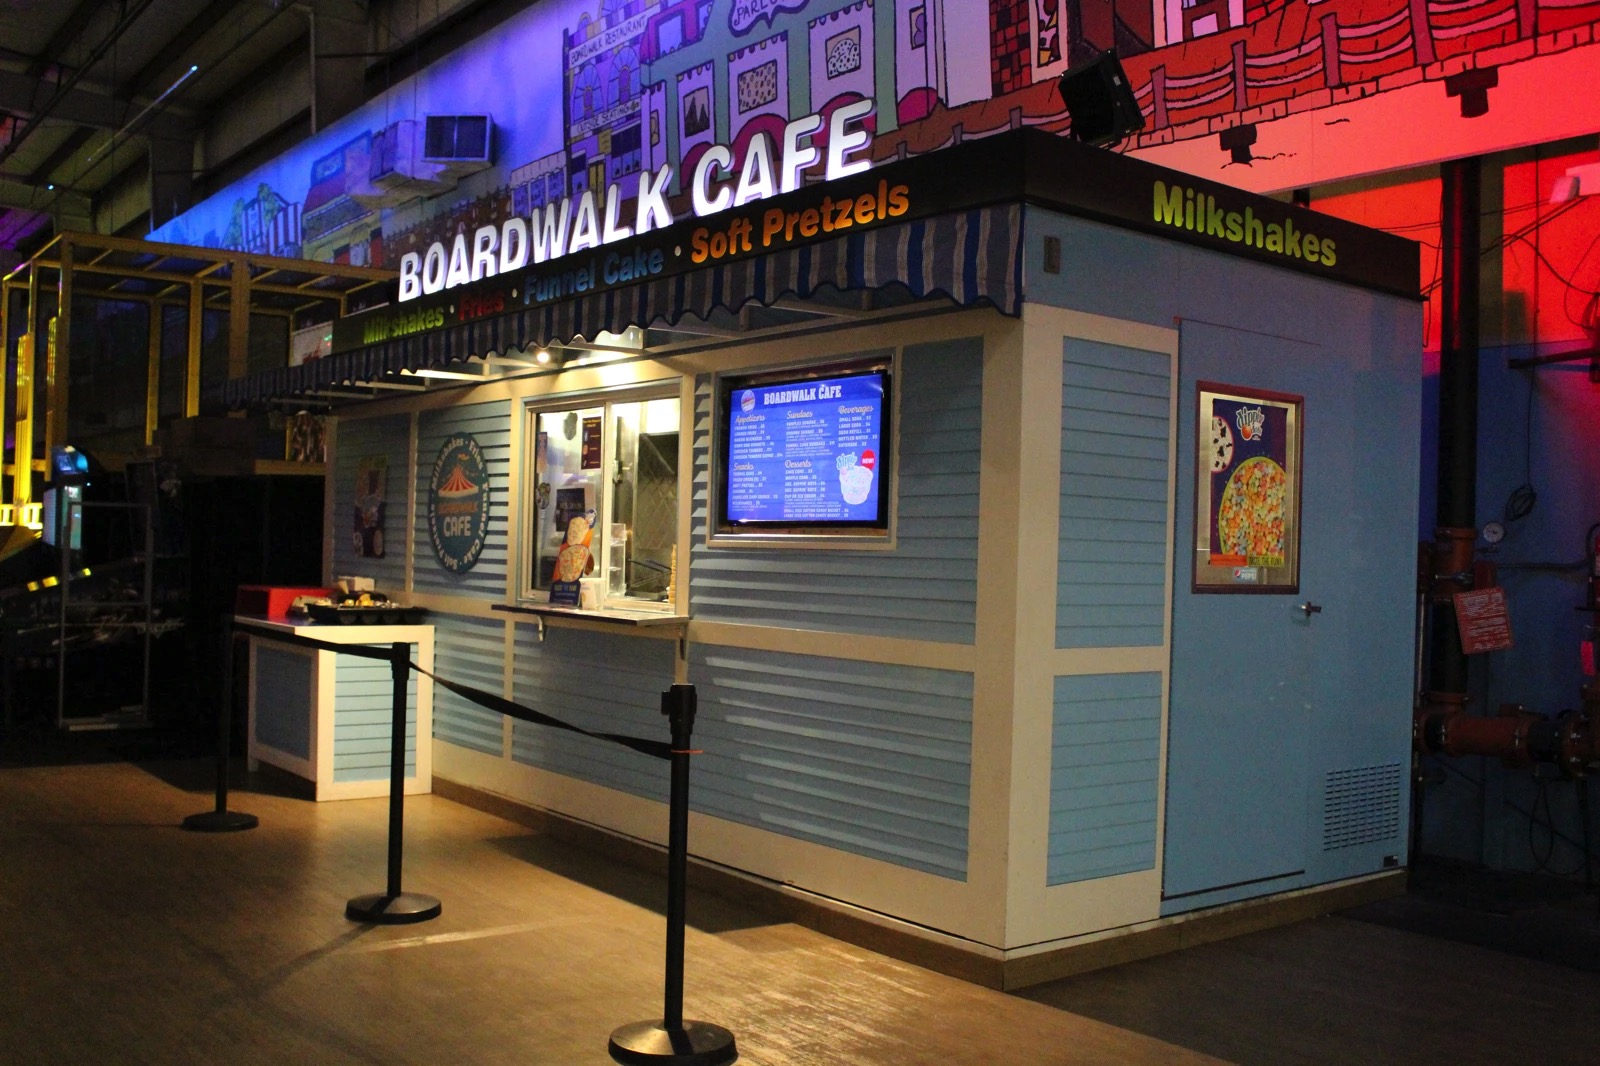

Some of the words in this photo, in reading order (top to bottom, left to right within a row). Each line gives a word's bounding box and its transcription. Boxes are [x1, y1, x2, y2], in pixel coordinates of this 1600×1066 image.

[733, 0, 786, 26] PARL
[605, 15, 647, 45] RESTAURANT
[602, 104, 629, 120] SEATING
[398, 162, 674, 302] BOARDWALK
[692, 100, 877, 218] CAFE
[1153, 180, 1337, 267] Milkshakes
[523, 257, 597, 305] Funnel
[602, 245, 665, 285] Cake
[691, 217, 753, 264] Soft
[762, 179, 909, 247] Pretzels
[763, 387, 816, 405] BOARDWALK
[818, 385, 842, 399] CAFE
[786, 409, 813, 420] Sundaes
[443, 516, 472, 537] CAFE
[1241, 572, 1257, 580] PEPSI
